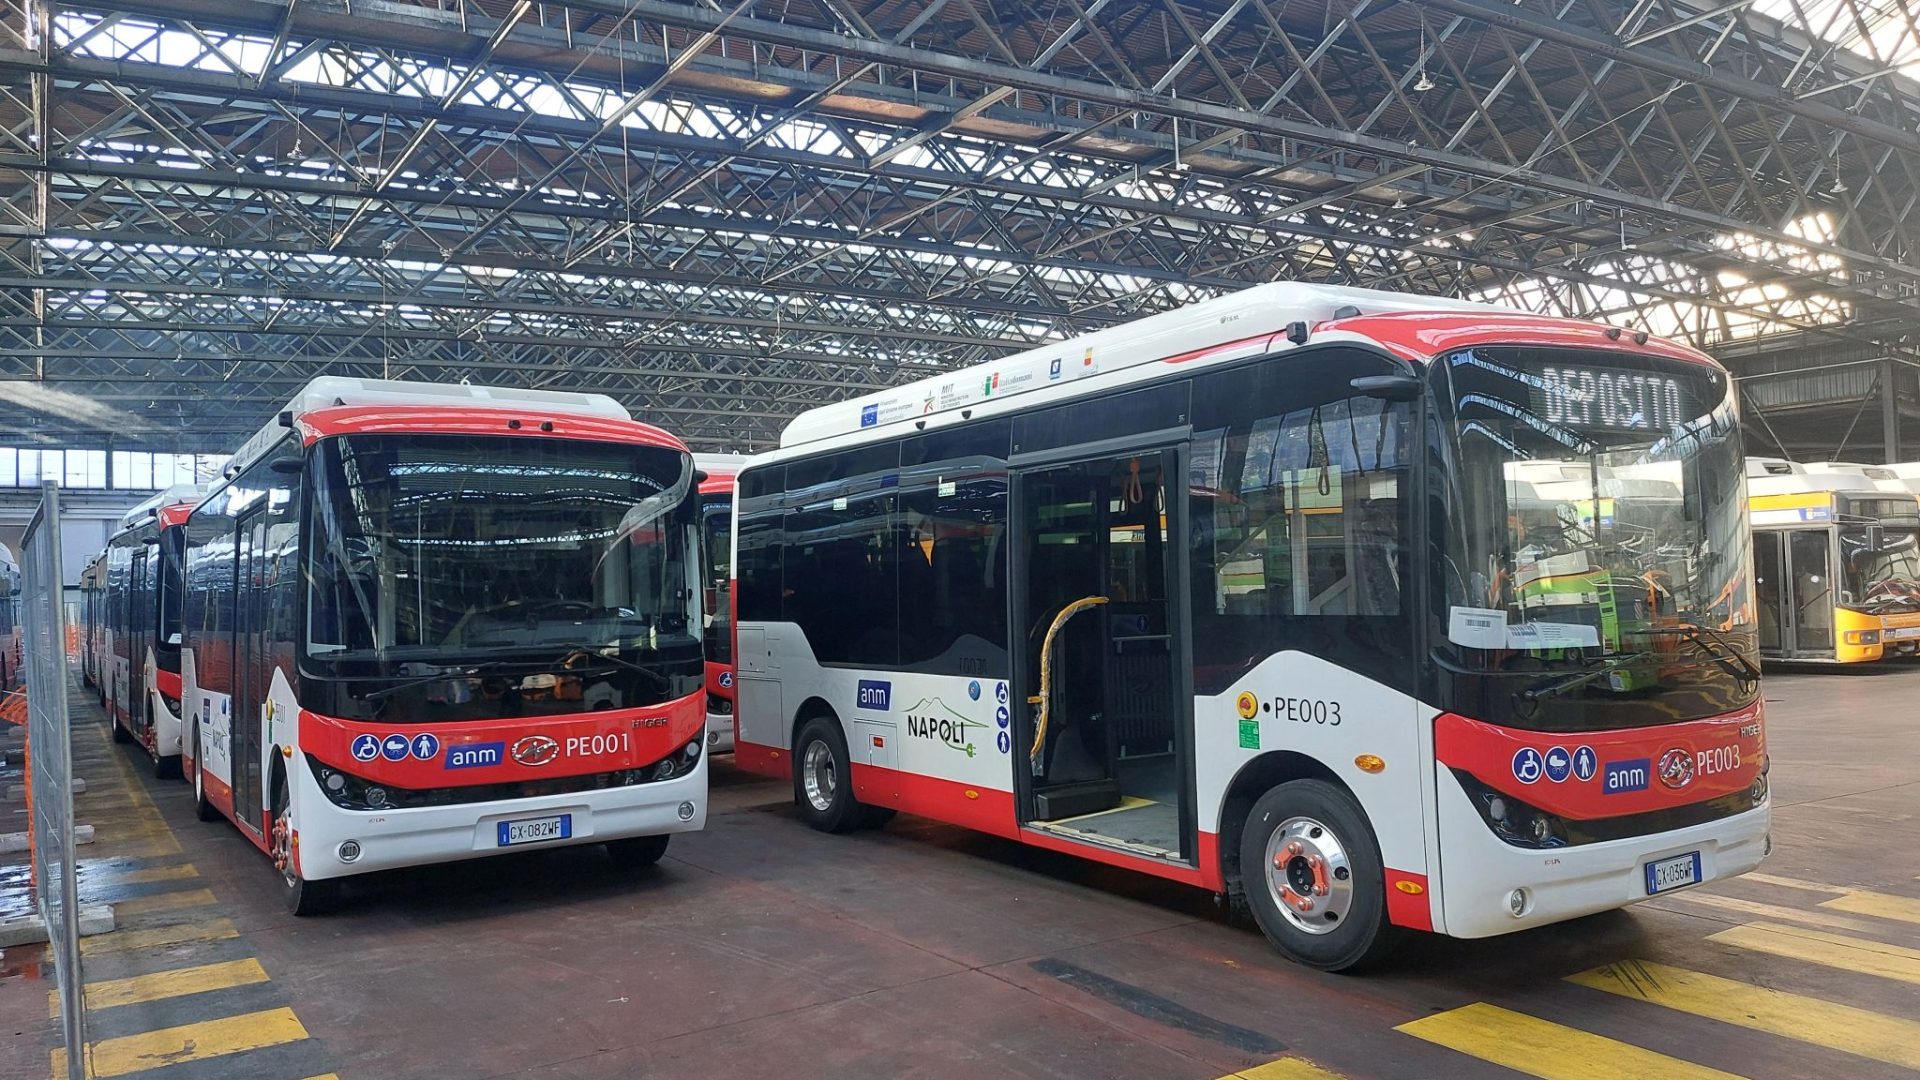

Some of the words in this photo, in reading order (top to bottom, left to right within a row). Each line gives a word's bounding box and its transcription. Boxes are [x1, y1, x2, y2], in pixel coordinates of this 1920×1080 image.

[1543, 367, 1681, 430] DEPOSITO
[861, 688, 886, 705] anm
[1275, 697, 1341, 726] PE003
[908, 715, 964, 744] NAPOLI
[453, 749, 496, 765] anm
[566, 733, 629, 757] PE001
[1697, 745, 1740, 776] PE003
[1609, 768, 1644, 789] anm
